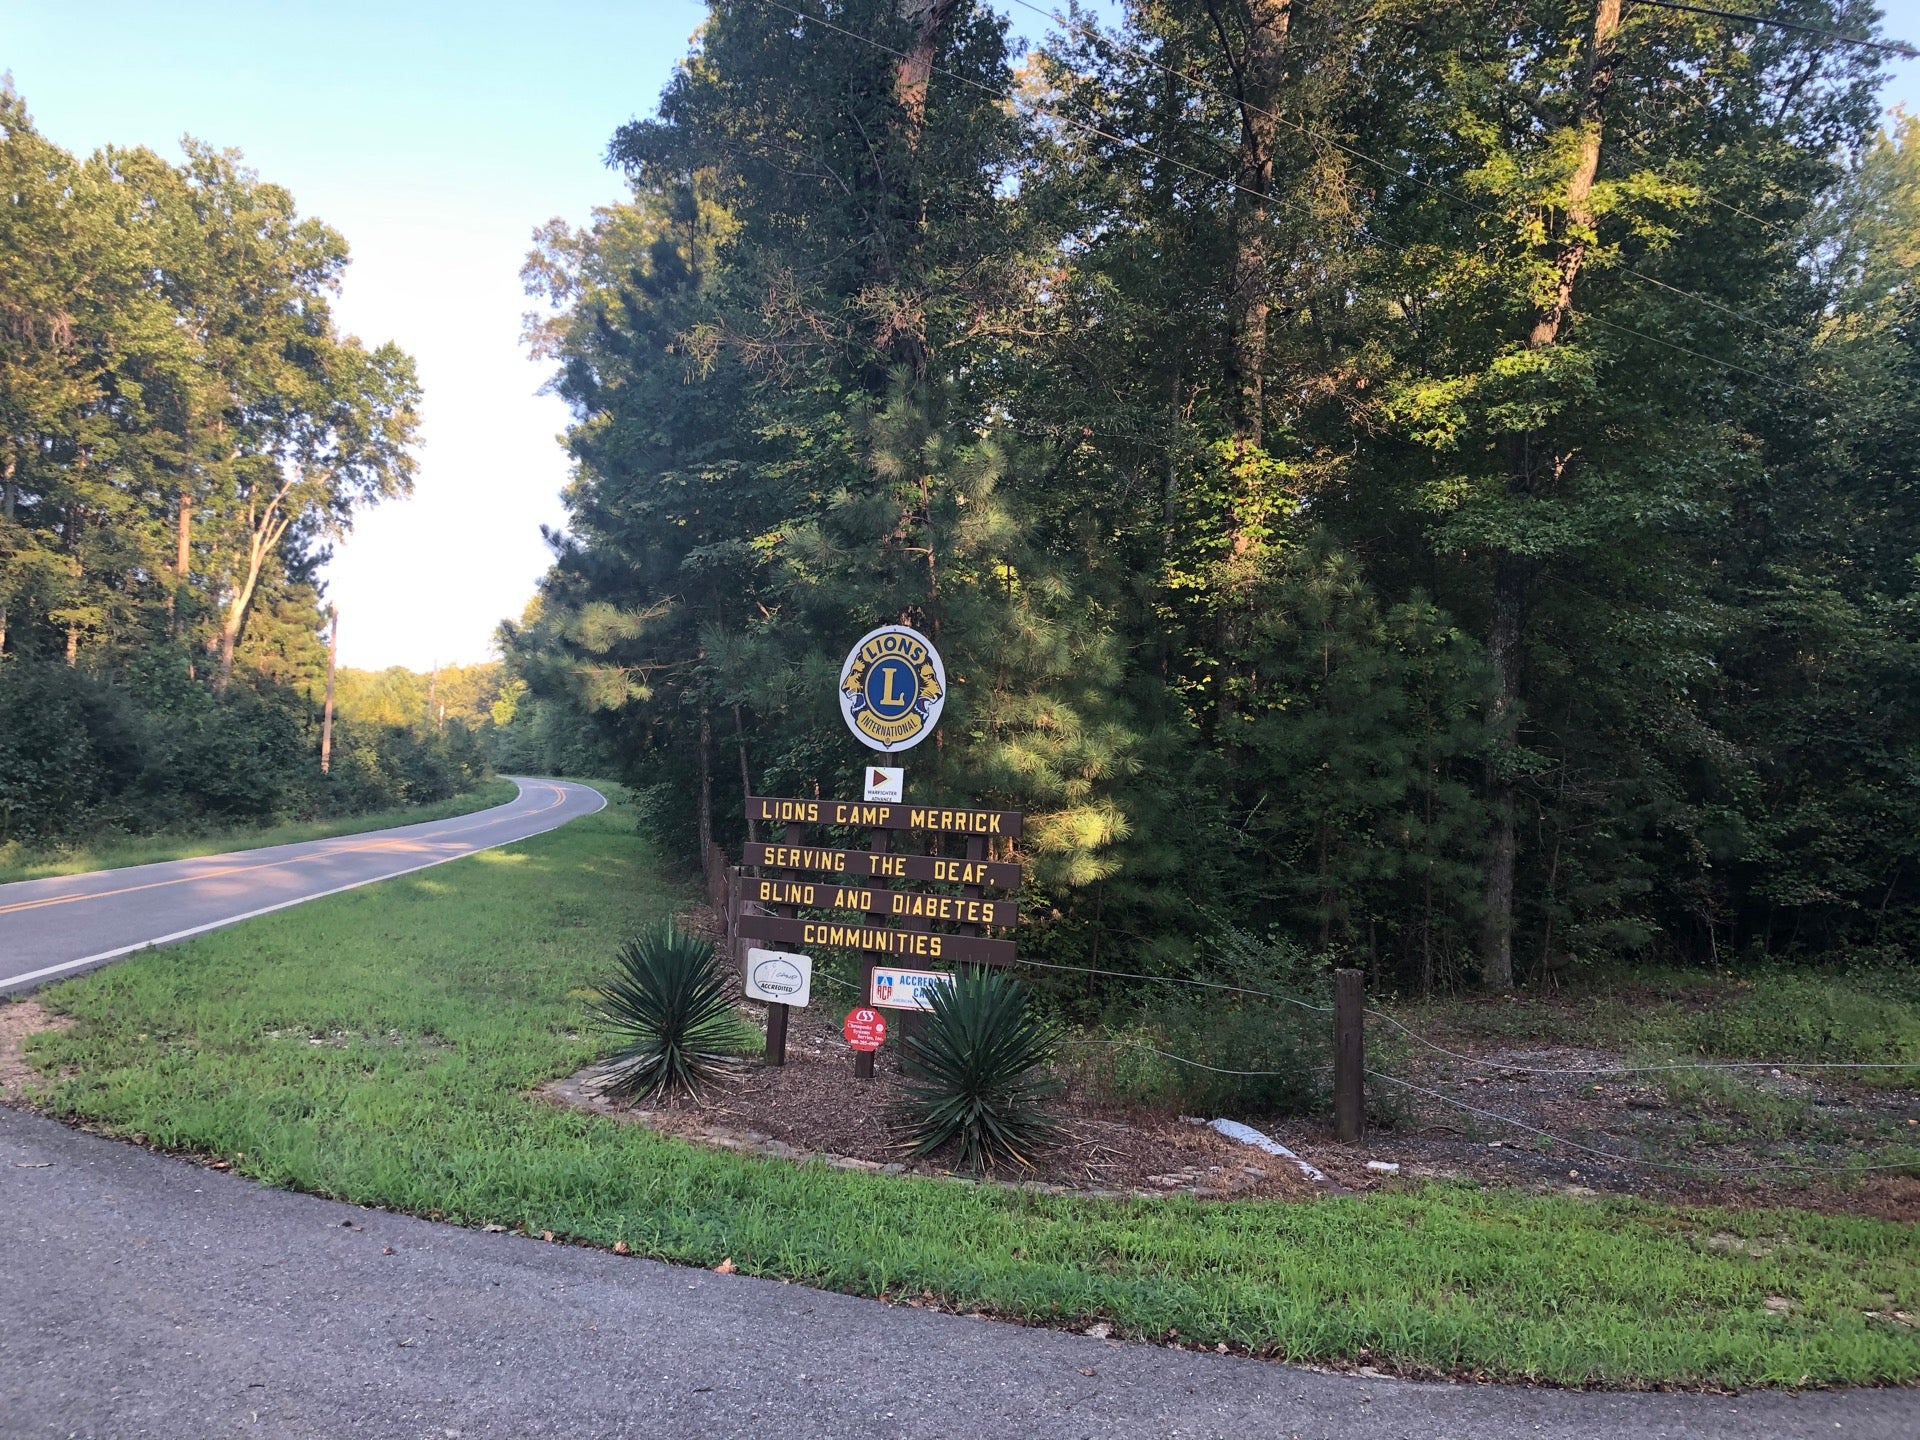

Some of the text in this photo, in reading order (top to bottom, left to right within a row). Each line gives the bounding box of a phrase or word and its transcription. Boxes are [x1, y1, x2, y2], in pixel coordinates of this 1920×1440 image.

[866, 637, 923, 661] LIONS
[880, 668, 905, 706] L
[861, 715, 918, 737] INTERNATIONAL
[762, 801, 1001, 833] LIONS CAMP MERRICK
[764, 847, 995, 885] SERVING THE DEAF,
[760, 882, 994, 922] BLIND AND DIABETES
[804, 925, 942, 956] COMMUNITIES
[761, 983, 793, 993] ACCREDITED
[900, 975, 952, 987] ACCRED
